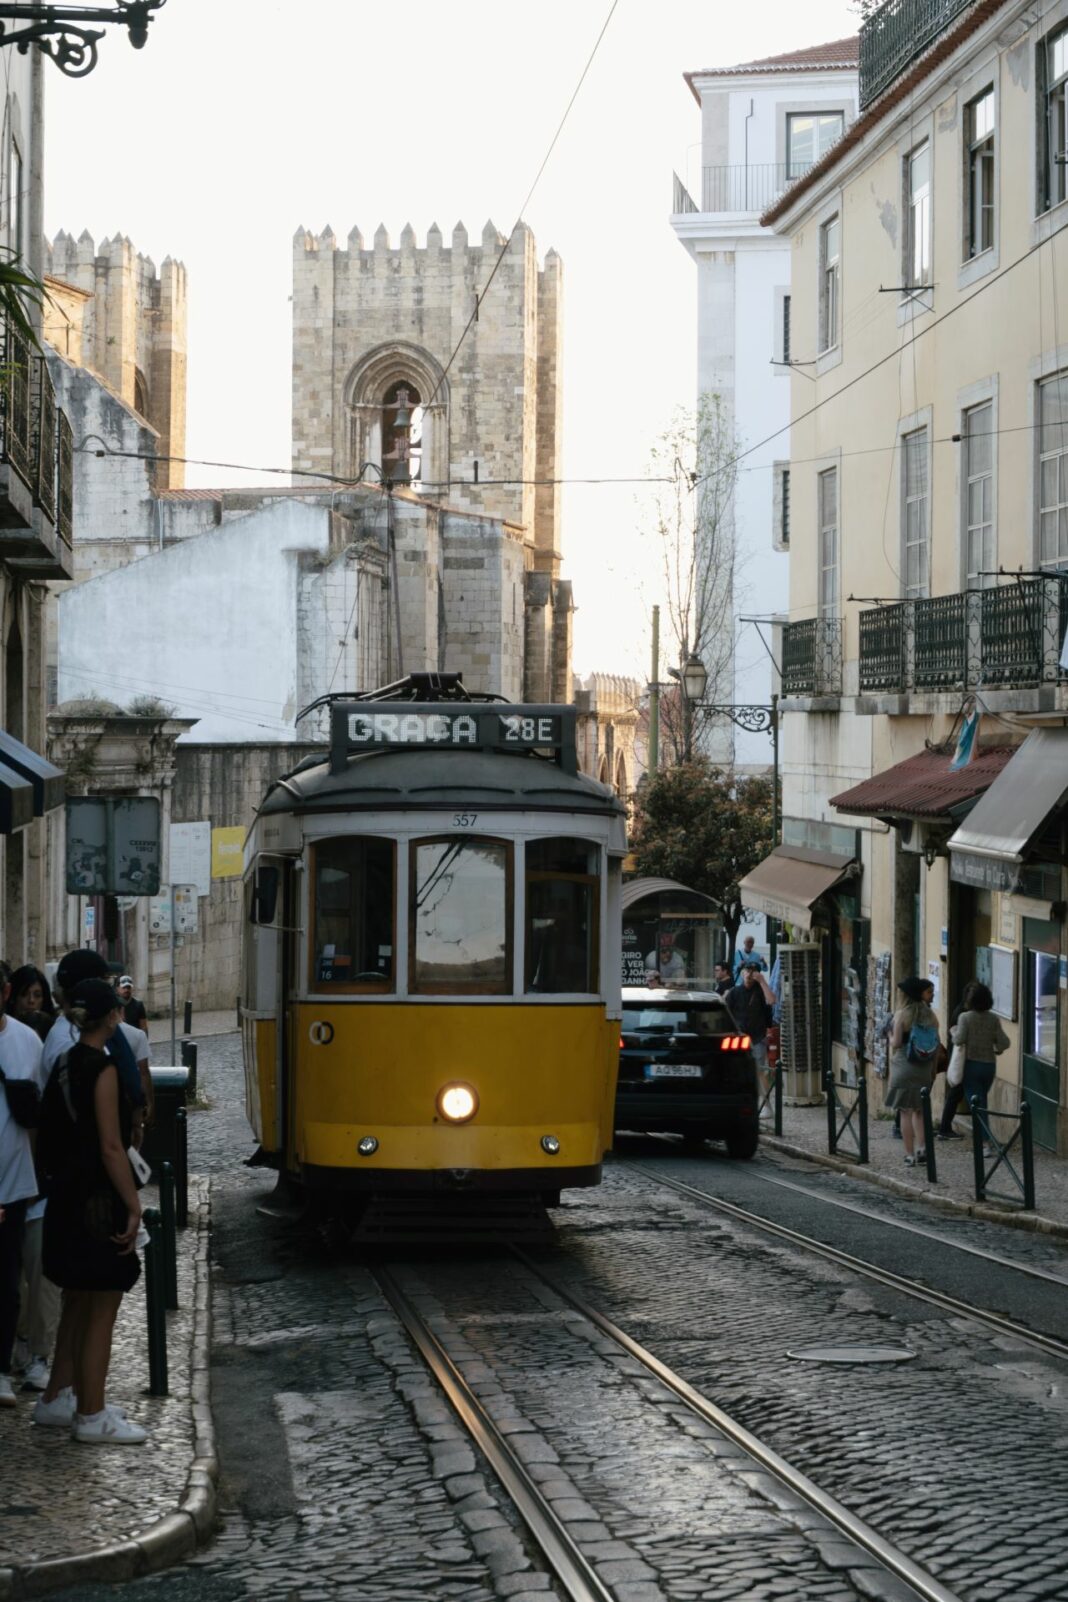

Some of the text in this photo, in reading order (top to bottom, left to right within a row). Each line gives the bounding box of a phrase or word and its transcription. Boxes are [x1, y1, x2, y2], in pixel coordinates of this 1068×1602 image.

[348, 713, 553, 743] GRAÇA 28E
[452, 814, 478, 827] 557
[627, 960, 644, 968] VER
[321, 970, 332, 980] 16
